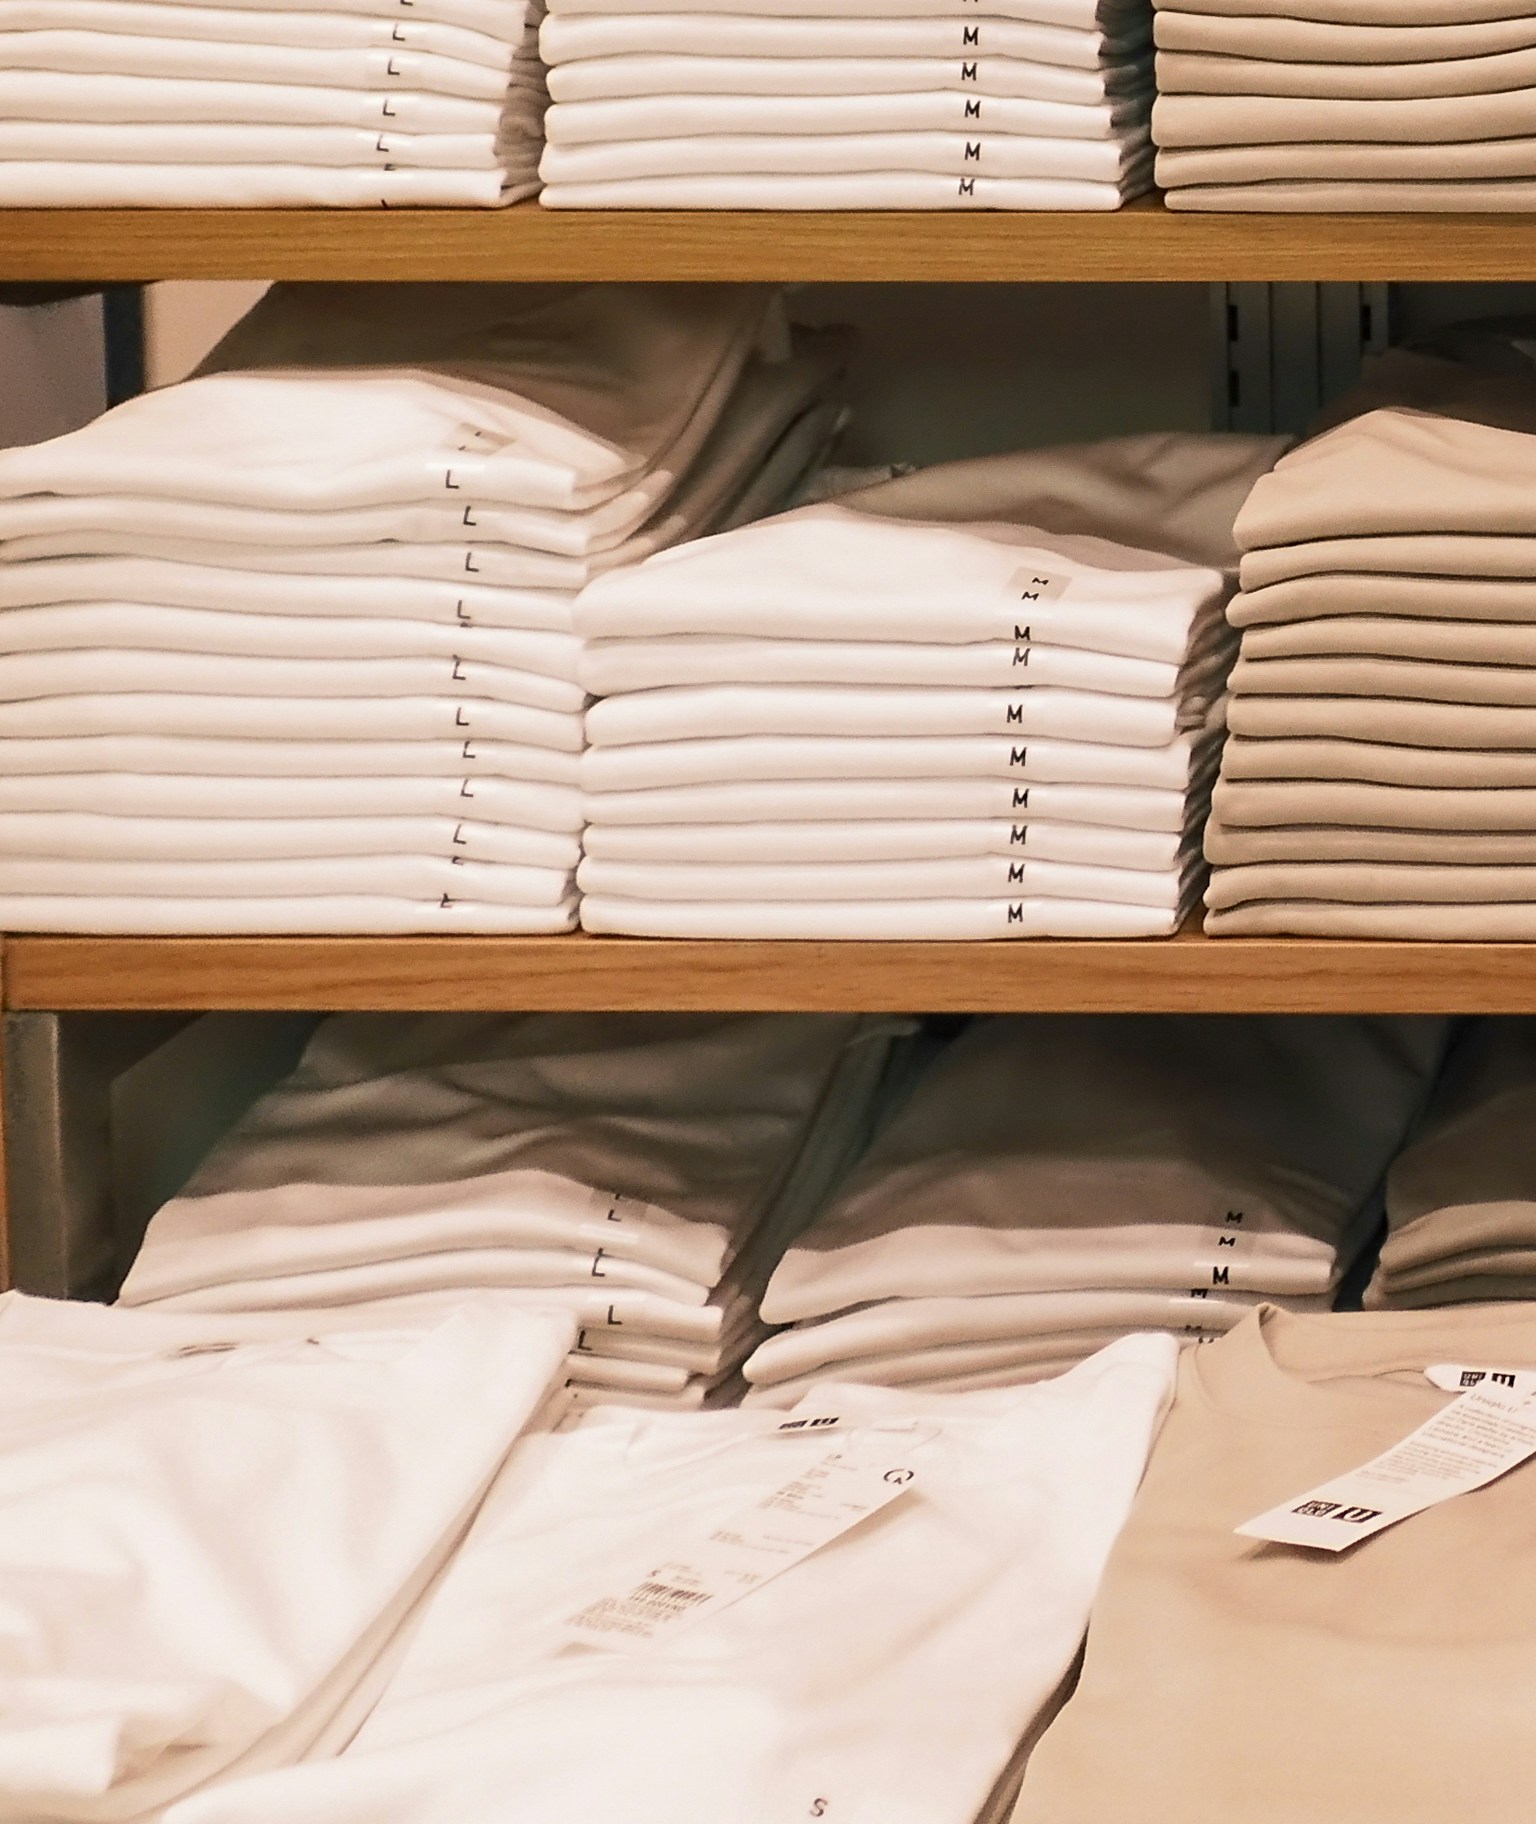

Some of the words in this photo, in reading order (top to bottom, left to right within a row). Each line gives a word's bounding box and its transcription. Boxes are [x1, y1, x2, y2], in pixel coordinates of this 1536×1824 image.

[963, 27, 978, 45] M
[387, 57, 400, 75] L
[965, 100, 980, 118] M
[965, 142, 980, 160] M
[446, 470, 459, 489] L
[463, 506, 476, 526] L
[466, 552, 479, 572] L
[456, 707, 469, 726] L
[1007, 704, 1022, 723] M
[1010, 747, 1026, 766] M
[1012, 788, 1029, 808] M
[453, 824, 466, 844] L
[1010, 825, 1027, 845] M
[1008, 863, 1025, 883] M
[1008, 903, 1023, 923] M
[608, 1209, 621, 1222] L
[1226, 1211, 1243, 1224] M
[1218, 1236, 1236, 1247] M
[1213, 1266, 1229, 1285] M
[608, 1305, 622, 1325] L
[578, 1330, 592, 1351] L
[809, 1797, 828, 1817] S
